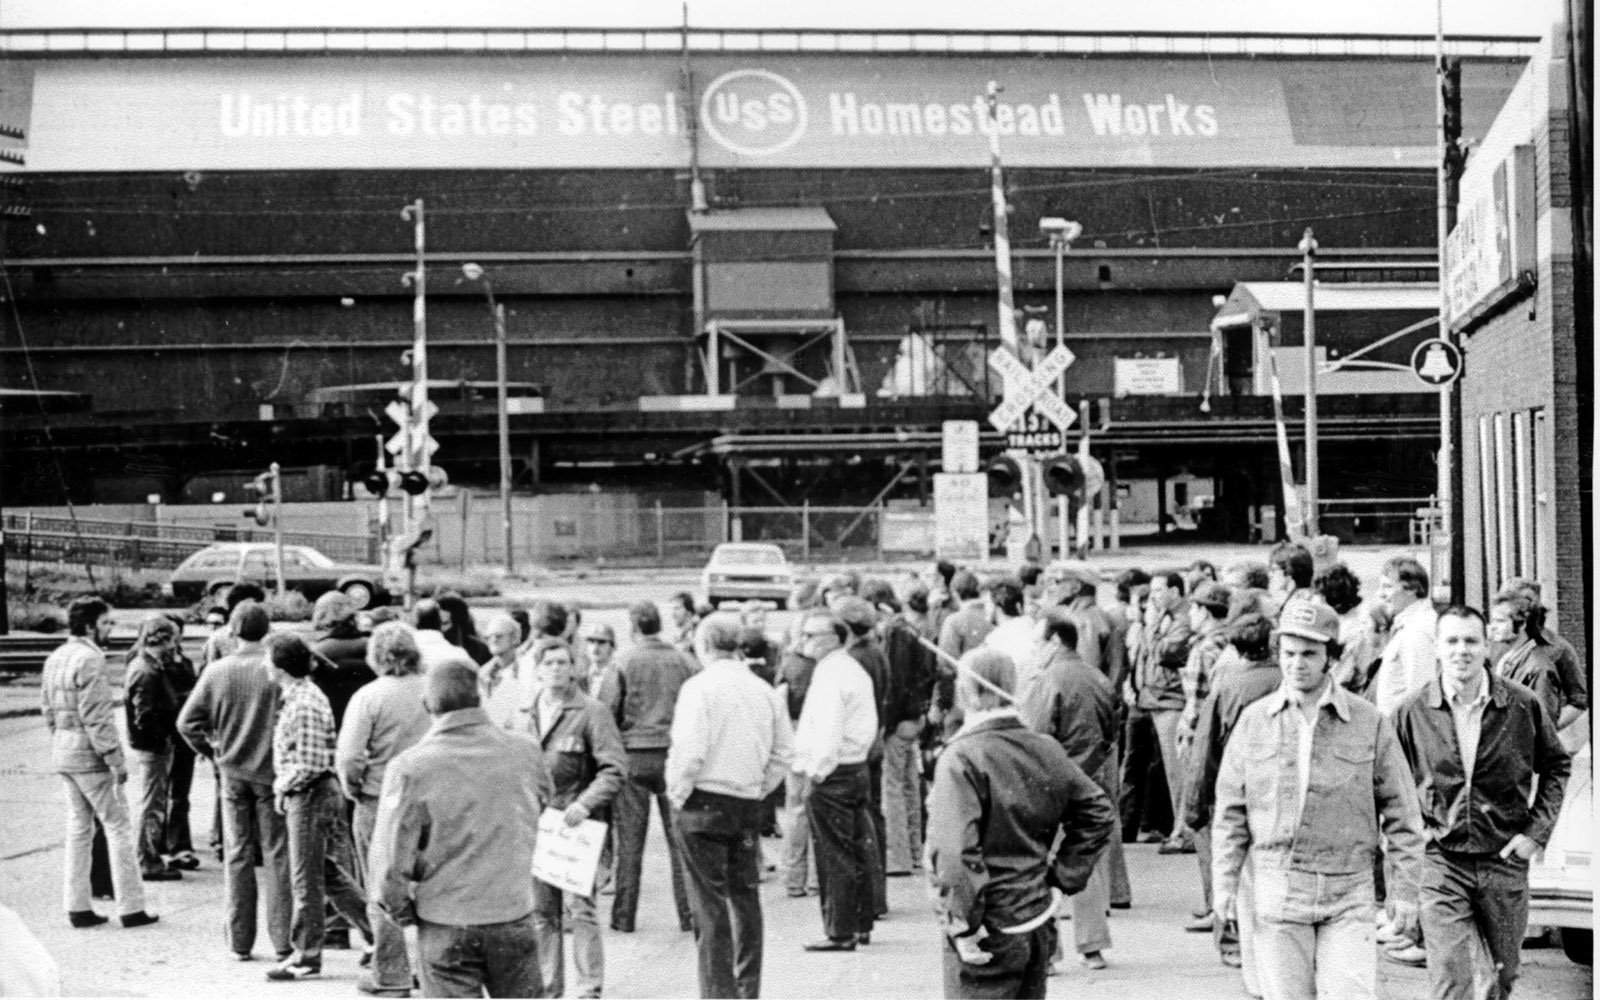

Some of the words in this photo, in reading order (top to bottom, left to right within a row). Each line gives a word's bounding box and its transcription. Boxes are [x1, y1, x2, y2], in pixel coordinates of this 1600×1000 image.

[220, 92, 361, 136] United
[386, 92, 539, 135] States
[557, 91, 678, 135] Steel
[828, 91, 1064, 136] Homestead
[1083, 93, 1219, 136] Works
[995, 350, 1070, 425] CROSSING
[1036, 390, 1071, 426] ROAD
[1008, 433, 1060, 447] TRACKS
